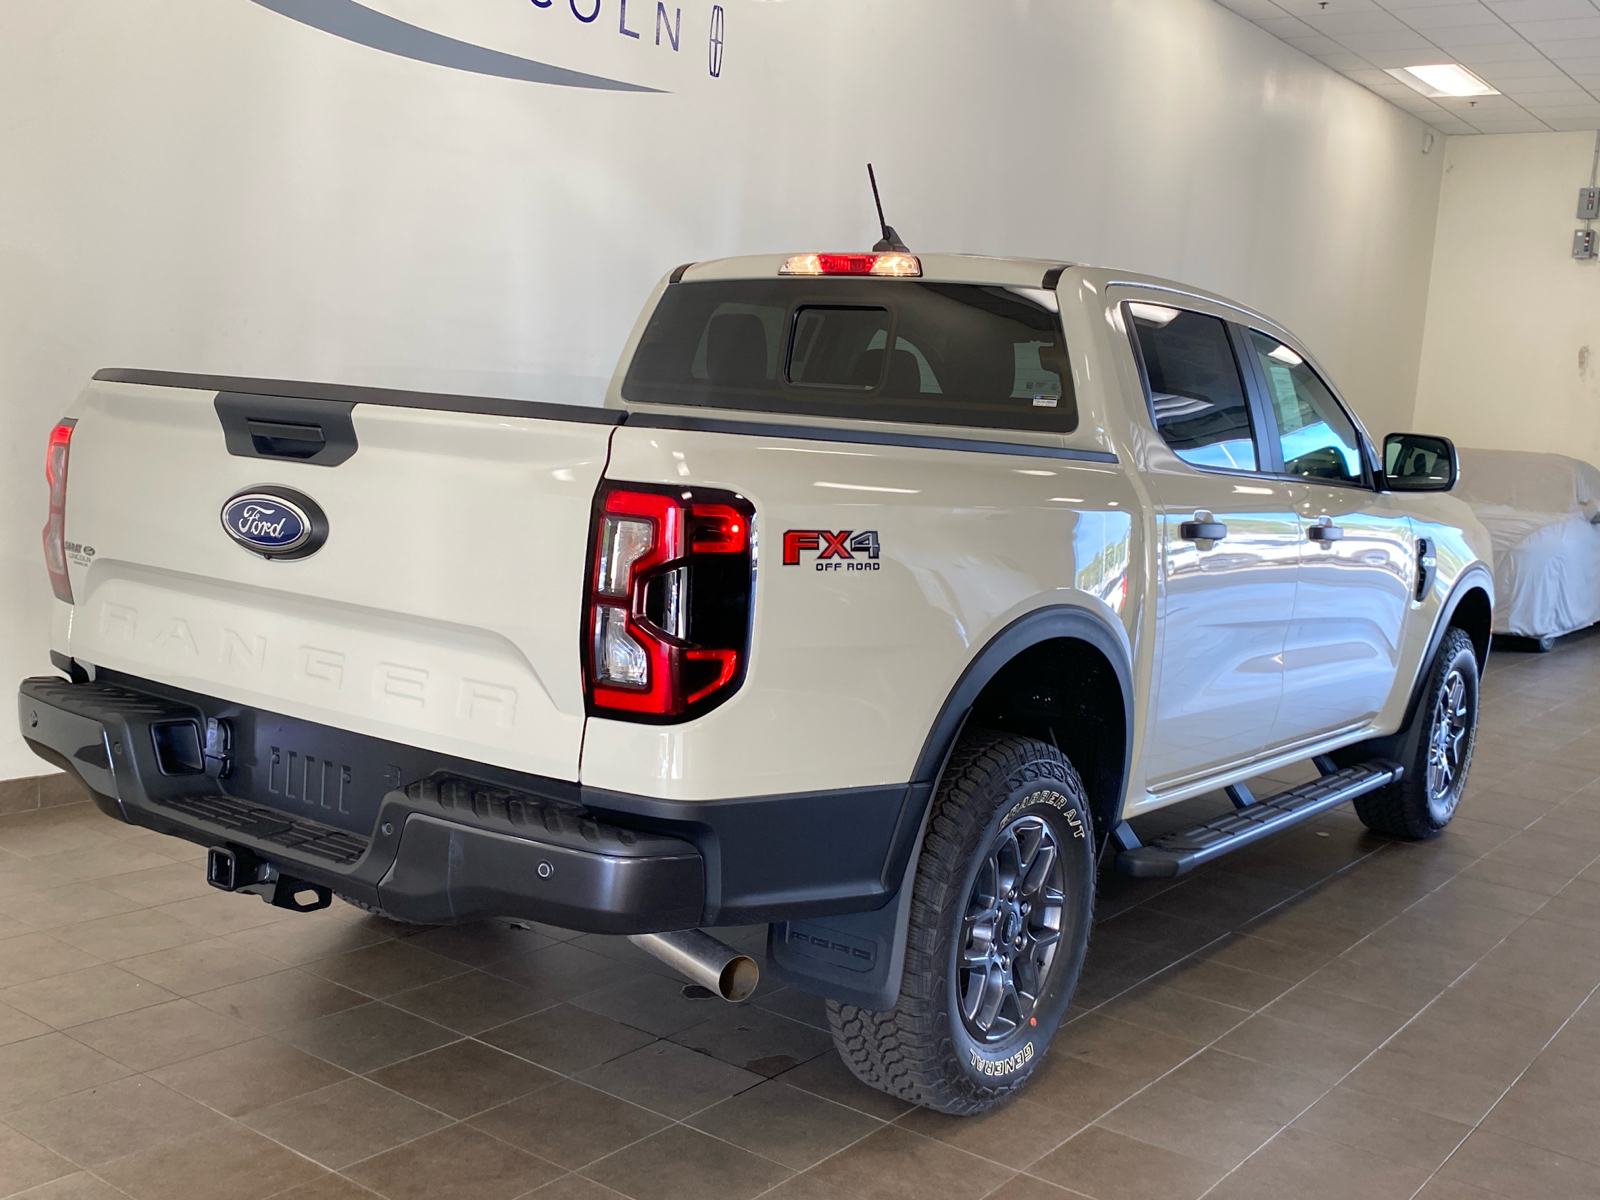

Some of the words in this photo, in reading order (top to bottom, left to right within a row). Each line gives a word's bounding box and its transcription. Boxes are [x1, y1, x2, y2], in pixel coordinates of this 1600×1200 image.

[238, 505, 287, 538] Ford
[783, 529, 880, 565] FX4
[816, 563, 842, 571] OFF
[847, 563, 880, 571] ROAD
[100, 601, 519, 727] RANGER
[1063, 808, 1085, 838] A/T
[969, 1041, 1034, 1076] GENERAL
